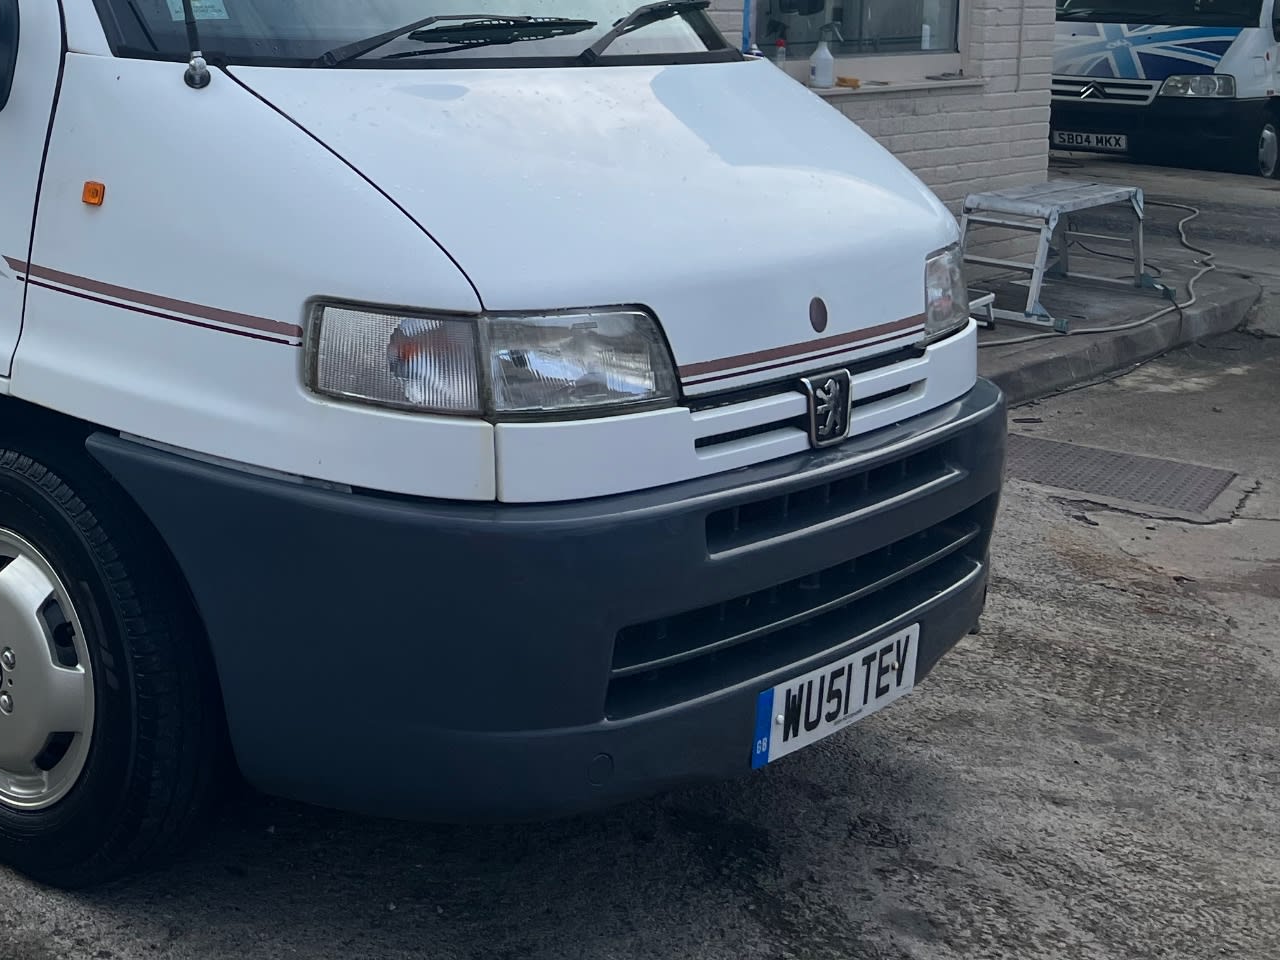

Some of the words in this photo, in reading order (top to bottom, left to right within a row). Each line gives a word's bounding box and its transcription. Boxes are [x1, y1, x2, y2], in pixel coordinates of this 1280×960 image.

[1058, 133, 1091, 145] SB04
[1095, 135, 1122, 147] MKX
[783, 663, 853, 743] WU51
[862, 635, 910, 706] TEV
[756, 737, 768, 754] GB
